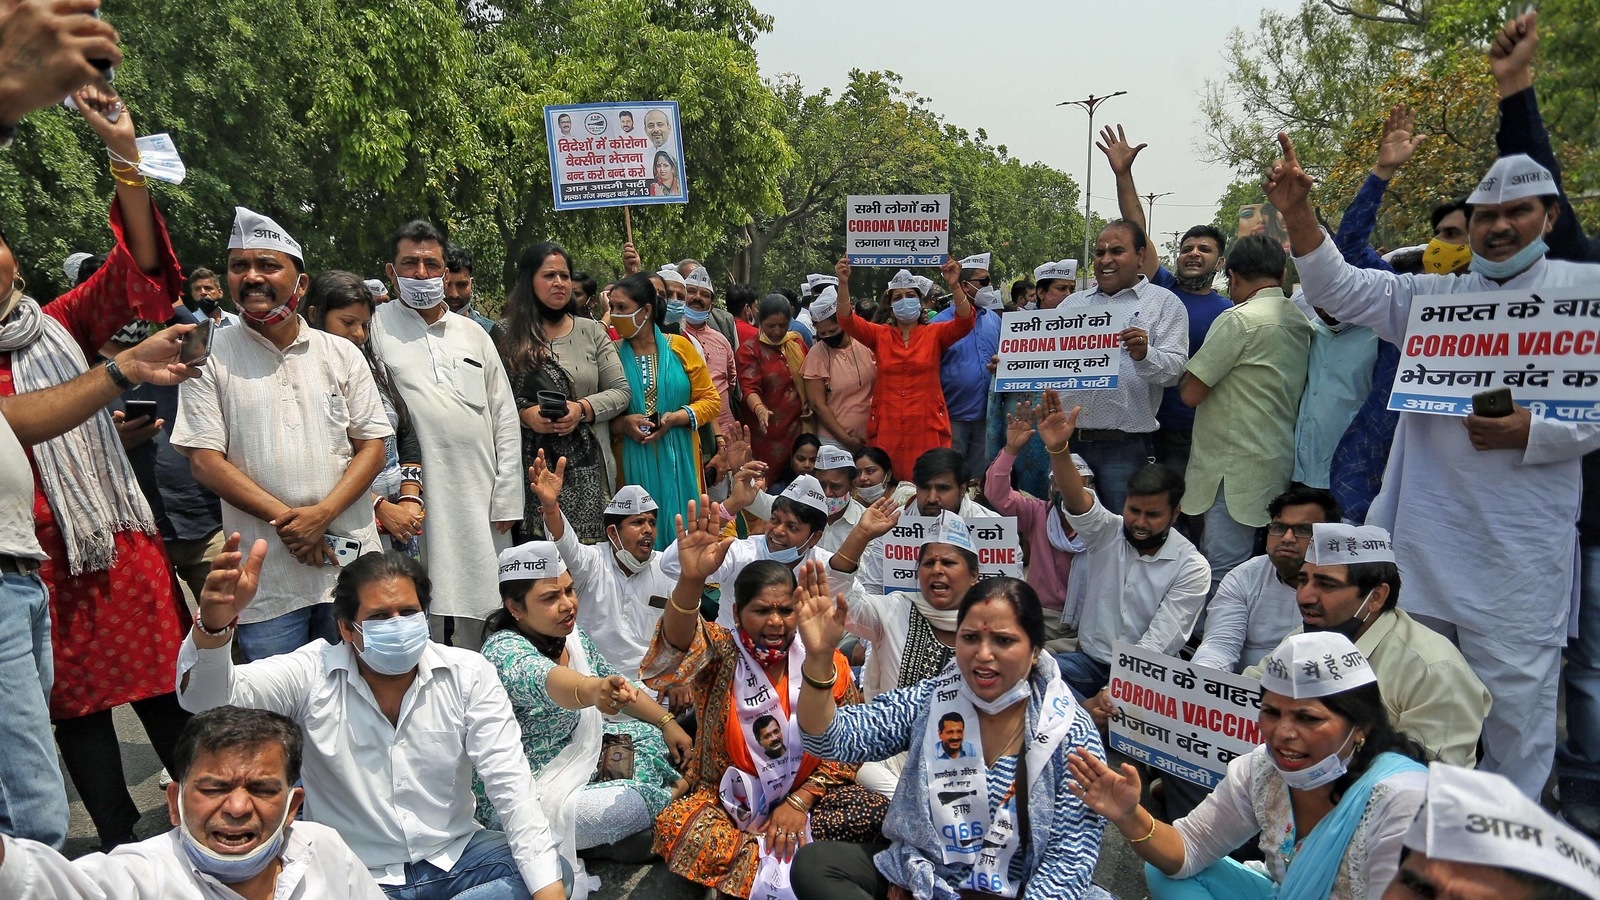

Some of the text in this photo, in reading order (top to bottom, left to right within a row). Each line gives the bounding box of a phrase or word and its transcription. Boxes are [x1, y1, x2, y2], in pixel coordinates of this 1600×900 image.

[558, 136, 647, 152] विदेशों में कोरोना
[566, 151, 643, 166] वैक्सीन भेजना
[566, 164, 646, 182] बन्द करो बन्द करो
[591, 181, 623, 190] आदमी
[626, 180, 646, 188] पार्टी
[640, 188, 649, 196] 13
[854, 200, 940, 213] सभी लोगों को
[848, 219, 947, 232] CORONA VACCINE
[254, 229, 281, 242] आम
[855, 236, 940, 251] लगाना चालू करो
[853, 255, 941, 265] आम आदमी पार्टी
[1420, 303, 1500, 322] भारत
[1507, 294, 1545, 318] के
[1010, 311, 1112, 332] सभी लोगों को
[1001, 333, 1120, 353] CORONA VACCINE
[1406, 333, 1509, 357] CORONA
[1007, 354, 1110, 373] लगाना चालू करो
[1003, 377, 1111, 390] आम आदमी पार्टी
[1400, 363, 1496, 387] भेजना
[1503, 363, 1554, 388] बंद
[1402, 398, 1457, 412] आम
[618, 500, 632, 509] पार्टी
[892, 523, 925, 538] सभी
[977, 524, 1004, 540] को
[1346, 537, 1358, 556] हूँ
[1362, 540, 1386, 550] आम
[523, 558, 547, 570] पार्टी
[1118, 653, 1168, 682] भारत
[1172, 668, 1198, 690] के
[744, 685, 770, 707] पार्टी
[1111, 677, 1178, 720] CORONA
[1112, 706, 1171, 744] भेजना
[1176, 732, 1211, 758] बंद
[1118, 739, 1212, 786] आम आदमी
[1465, 813, 1543, 848] आम
